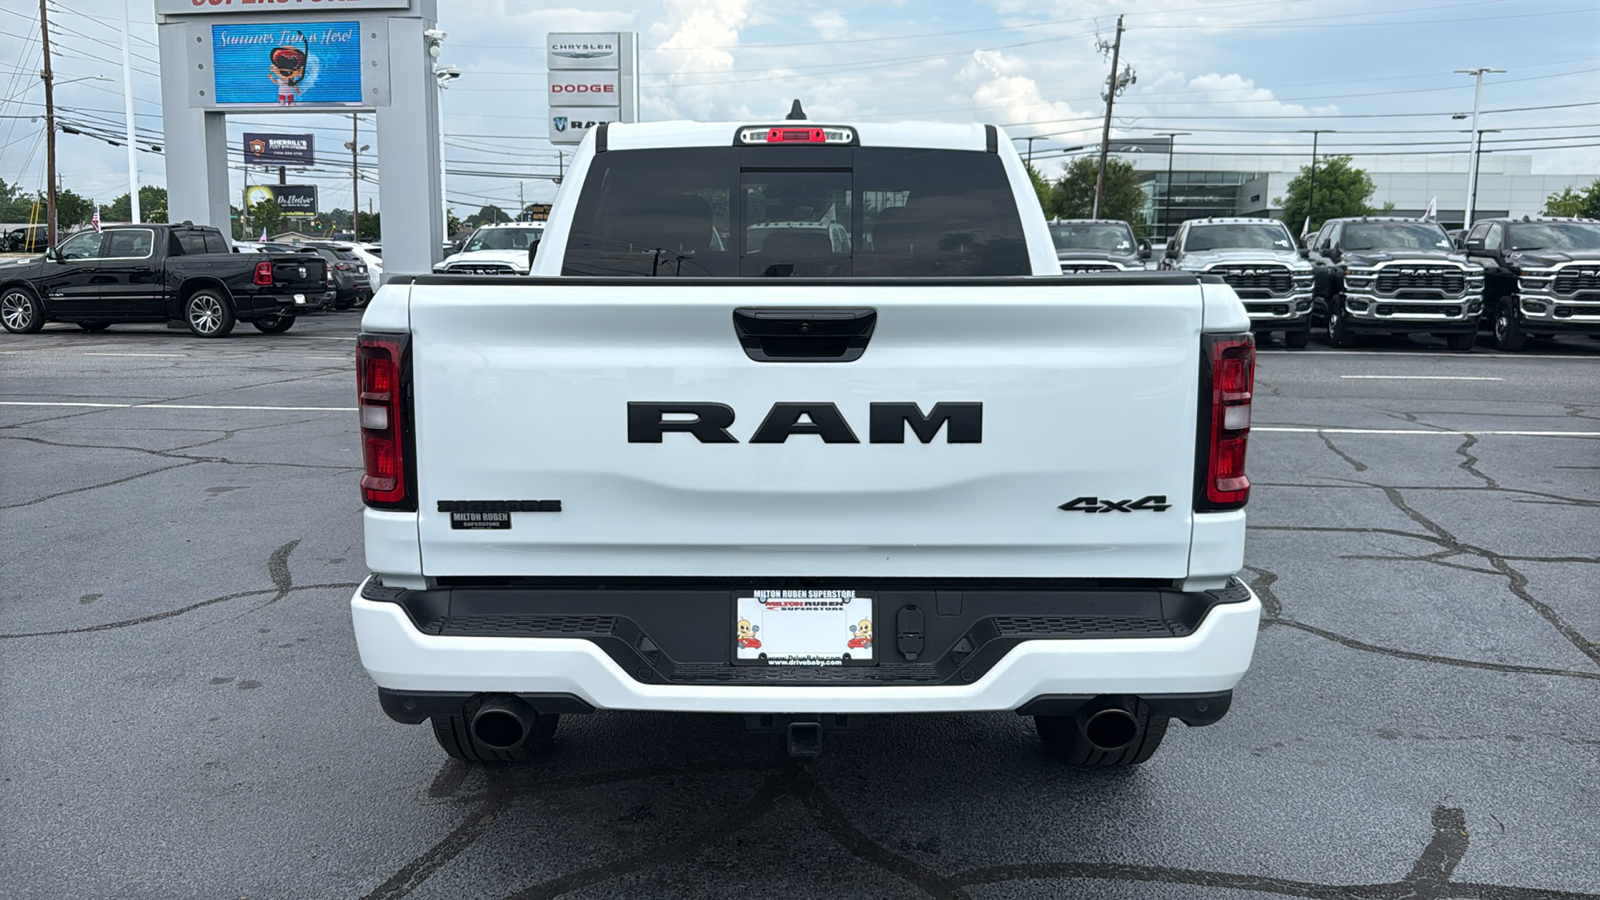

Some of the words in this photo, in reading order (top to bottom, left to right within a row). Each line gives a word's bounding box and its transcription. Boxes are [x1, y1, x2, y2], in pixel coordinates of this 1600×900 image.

[220, 31, 274, 47] Summer
[278, 29, 306, 46] Fun
[309, 31, 318, 43] is
[321, 28, 353, 45] Here!
[552, 84, 615, 93] DODGE
[627, 401, 983, 443] RAM
[1057, 495, 1173, 513] 4x4
[453, 512, 482, 521] MILTON
[482, 512, 508, 521] RUBEN
[753, 590, 781, 598] MILTON
[782, 590, 807, 598] RUBEN
[808, 590, 856, 598] SUPERSTORE
